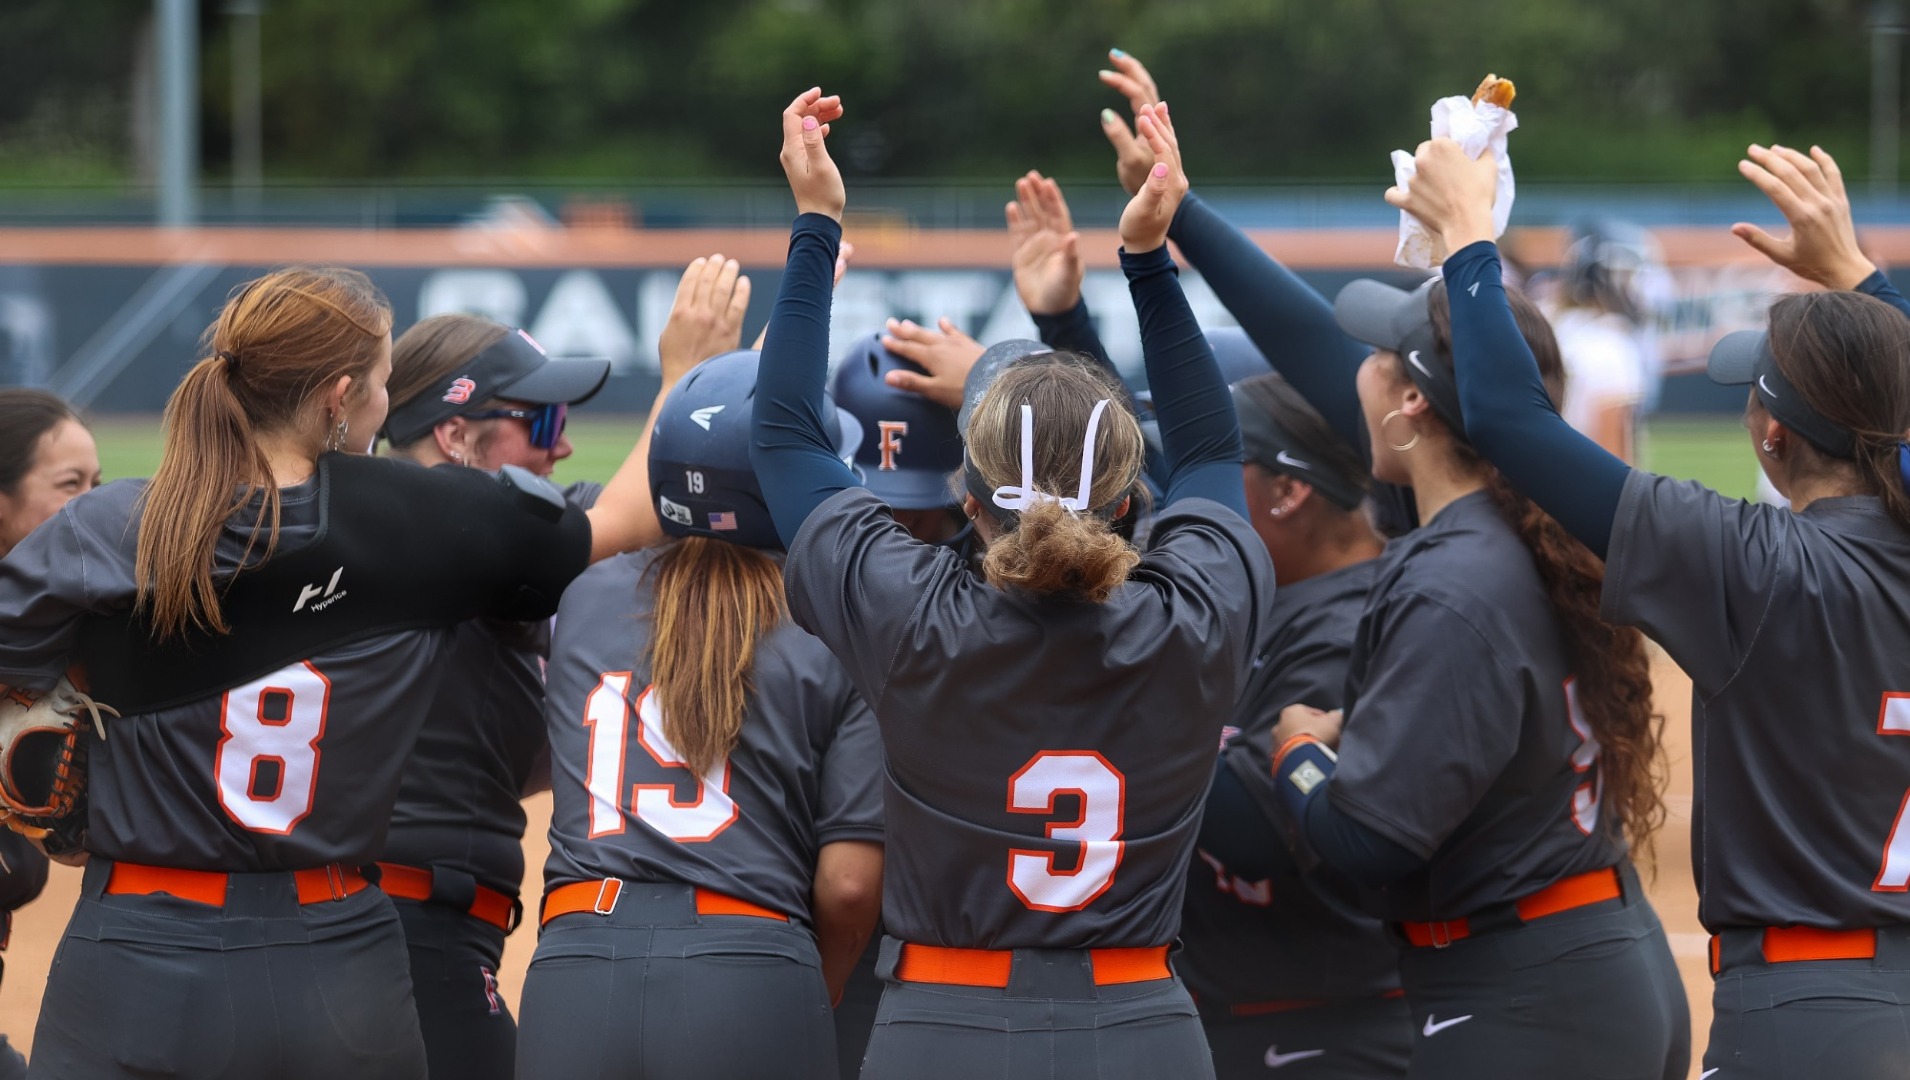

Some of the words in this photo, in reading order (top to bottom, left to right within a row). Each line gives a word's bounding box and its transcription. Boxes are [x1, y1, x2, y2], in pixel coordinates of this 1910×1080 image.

[685, 470, 705, 494] 19
[877, 420, 908, 471] F
[310, 589, 347, 613] Hyperice
[213, 659, 332, 836] 8
[582, 670, 739, 842] 19
[1006, 749, 1126, 914] 3
